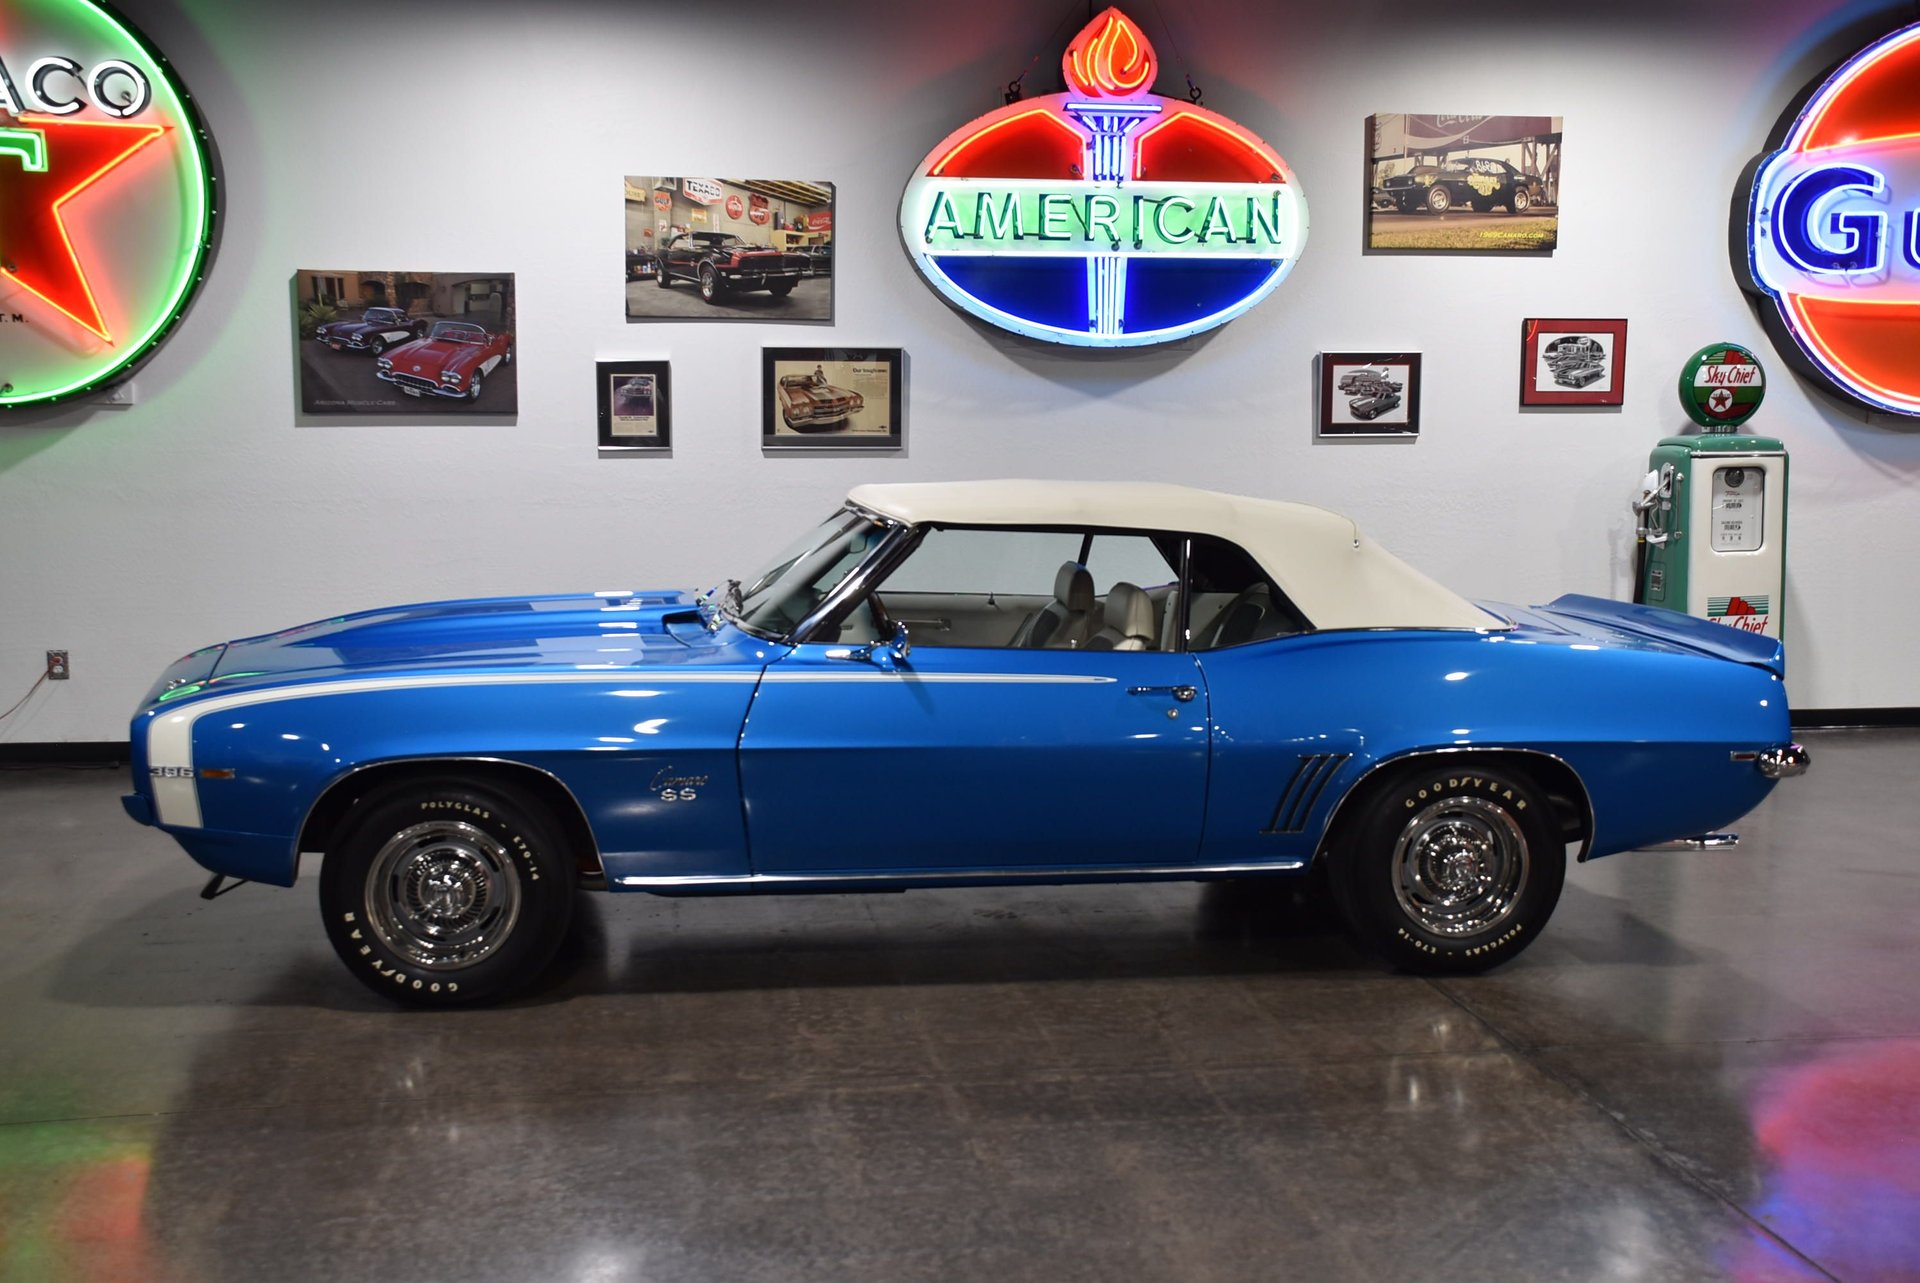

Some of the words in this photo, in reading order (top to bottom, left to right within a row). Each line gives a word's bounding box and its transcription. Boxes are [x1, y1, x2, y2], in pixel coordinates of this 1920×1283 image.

[686, 180, 720, 197] TEXACO
[925, 191, 1283, 244] AMERICAN
[1771, 163, 1920, 275] G
[1704, 365, 1727, 386] Sky
[1728, 366, 1756, 384] Chief
[149, 766, 194, 778] 396
[660, 787, 697, 801] SS
[1405, 777, 1527, 810] GOODYEAR
[421, 801, 491, 819] POLYGLAS
[344, 911, 458, 992] GOODYEAR
[1465, 923, 1523, 956] POLYGLAS
